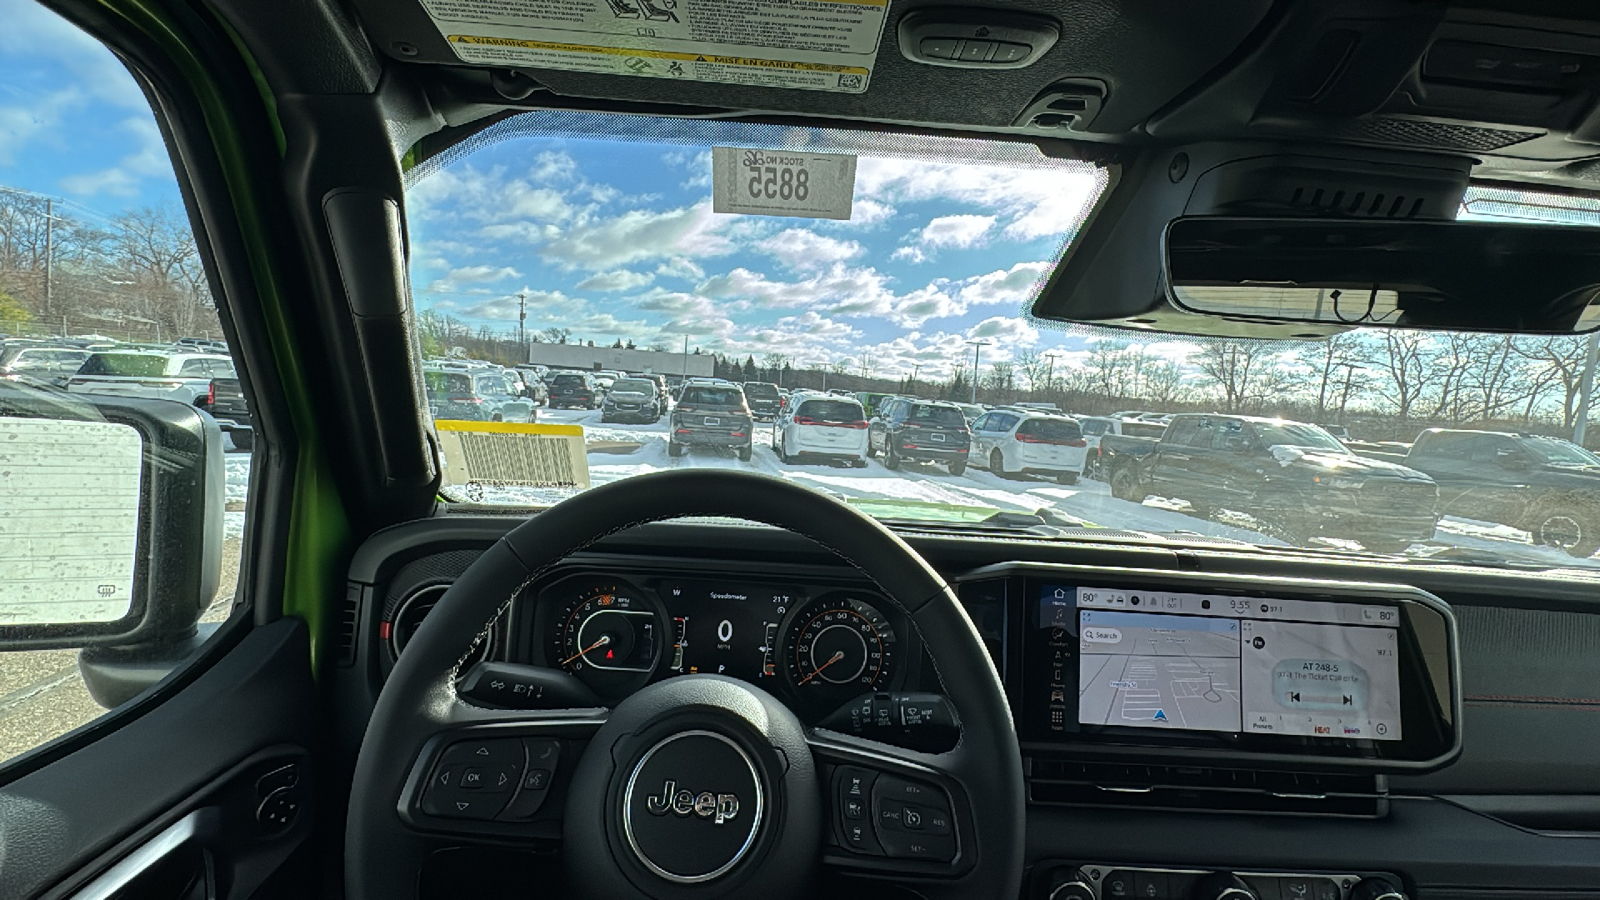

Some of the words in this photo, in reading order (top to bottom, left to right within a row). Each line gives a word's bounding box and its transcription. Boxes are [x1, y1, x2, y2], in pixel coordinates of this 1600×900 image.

[473, 37, 529, 48] WARNING
[714, 56, 740, 64] MISE
[743, 58, 758, 66] EN
[760, 60, 795, 69] GARDE
[673, 588, 681, 596] W
[709, 591, 748, 601] Speedometer
[584, 602, 591, 611] 5
[574, 612, 580, 620] 4
[568, 624, 574, 633] 3
[717, 619, 733, 642] 0
[861, 624, 871, 632] 80
[1096, 632, 1118, 640] Search
[566, 638, 573, 646] 2
[576, 662, 583, 670] 0
[718, 664, 726, 673] P
[1302, 662, 1314, 671] AT
[1315, 663, 1339, 672] 248-5
[1308, 673, 1328, 681] Ticket
[467, 773, 480, 782] OK
[647, 780, 740, 824] Jeep
